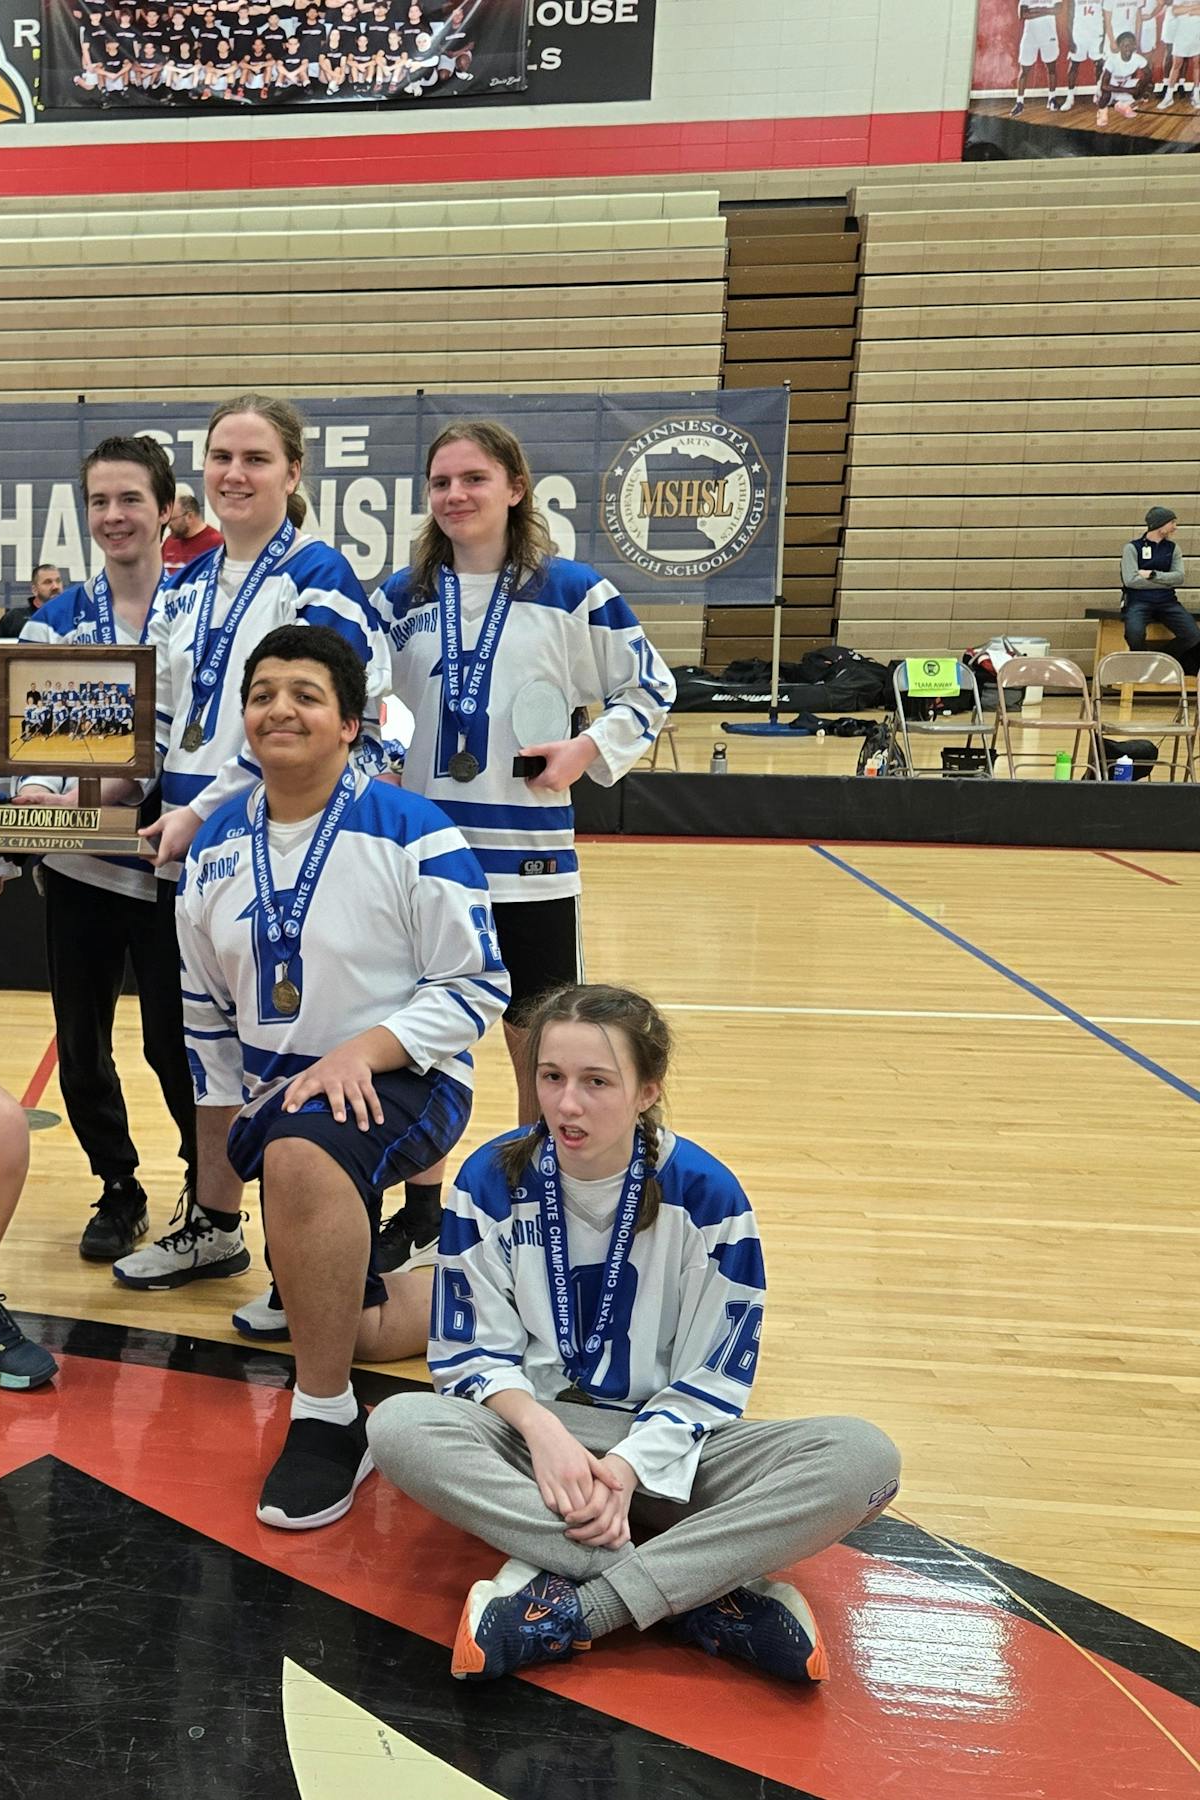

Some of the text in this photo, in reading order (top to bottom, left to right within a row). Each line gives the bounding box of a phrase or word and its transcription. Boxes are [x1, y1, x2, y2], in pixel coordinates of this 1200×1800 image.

[627, 420, 750, 457] MINNESOTA
[676, 438, 711, 447] ARTS
[605, 489, 766, 576] STATE HIGH SCHOOL LEAGUE
[637, 479, 733, 518] MSHSL
[97, 596, 110, 623] STATE
[210, 556, 274, 669] STATE CHAMPIONSHIPS
[446, 576, 459, 696] STATE CHAMPIONSHIPS
[468, 574, 512, 696] STATE CHAMPIONSHIPS
[8, 837, 84, 849] CHAMPION
[18, 809, 53, 829] FLOOR
[54, 810, 99, 830] HOCKEY
[292, 790, 350, 919] STATE CHAMPIONSHIPS
[254, 833, 277, 923] CHAMPIONSHIPS
[545, 1181, 570, 1336] STATE CHAMPIONSHIPS
[596, 1183, 642, 1331] STATE CHAMPIONSHIPS
